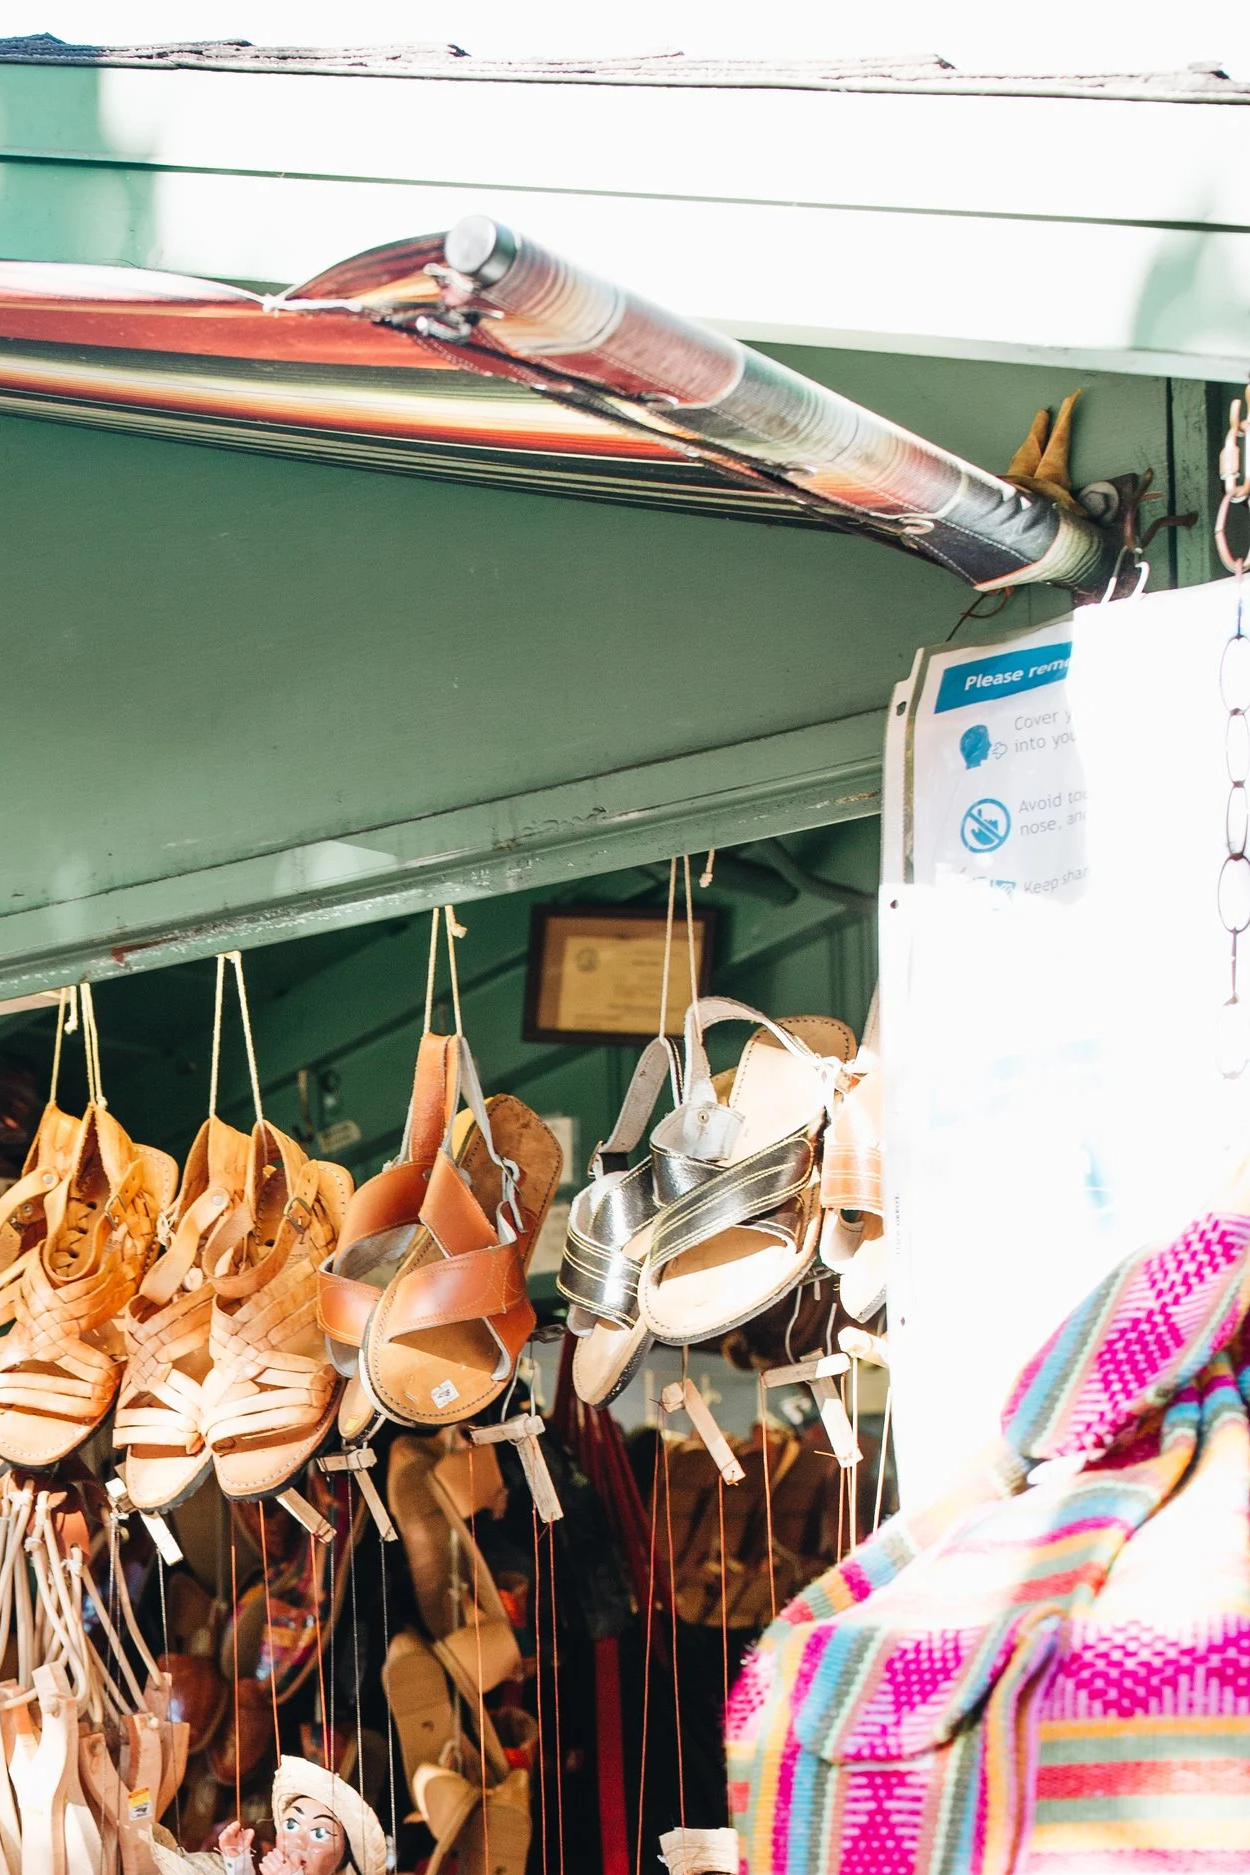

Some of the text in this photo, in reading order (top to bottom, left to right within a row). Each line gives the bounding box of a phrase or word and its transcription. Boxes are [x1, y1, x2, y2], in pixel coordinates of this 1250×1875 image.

[964, 669, 1024, 691] Please
[1014, 711, 1058, 731] Cover
[1014, 736, 1047, 753] into
[1018, 792, 1062, 814] Avoid
[1020, 819, 1062, 836] nose,
[1023, 877, 1059, 895] Keep
